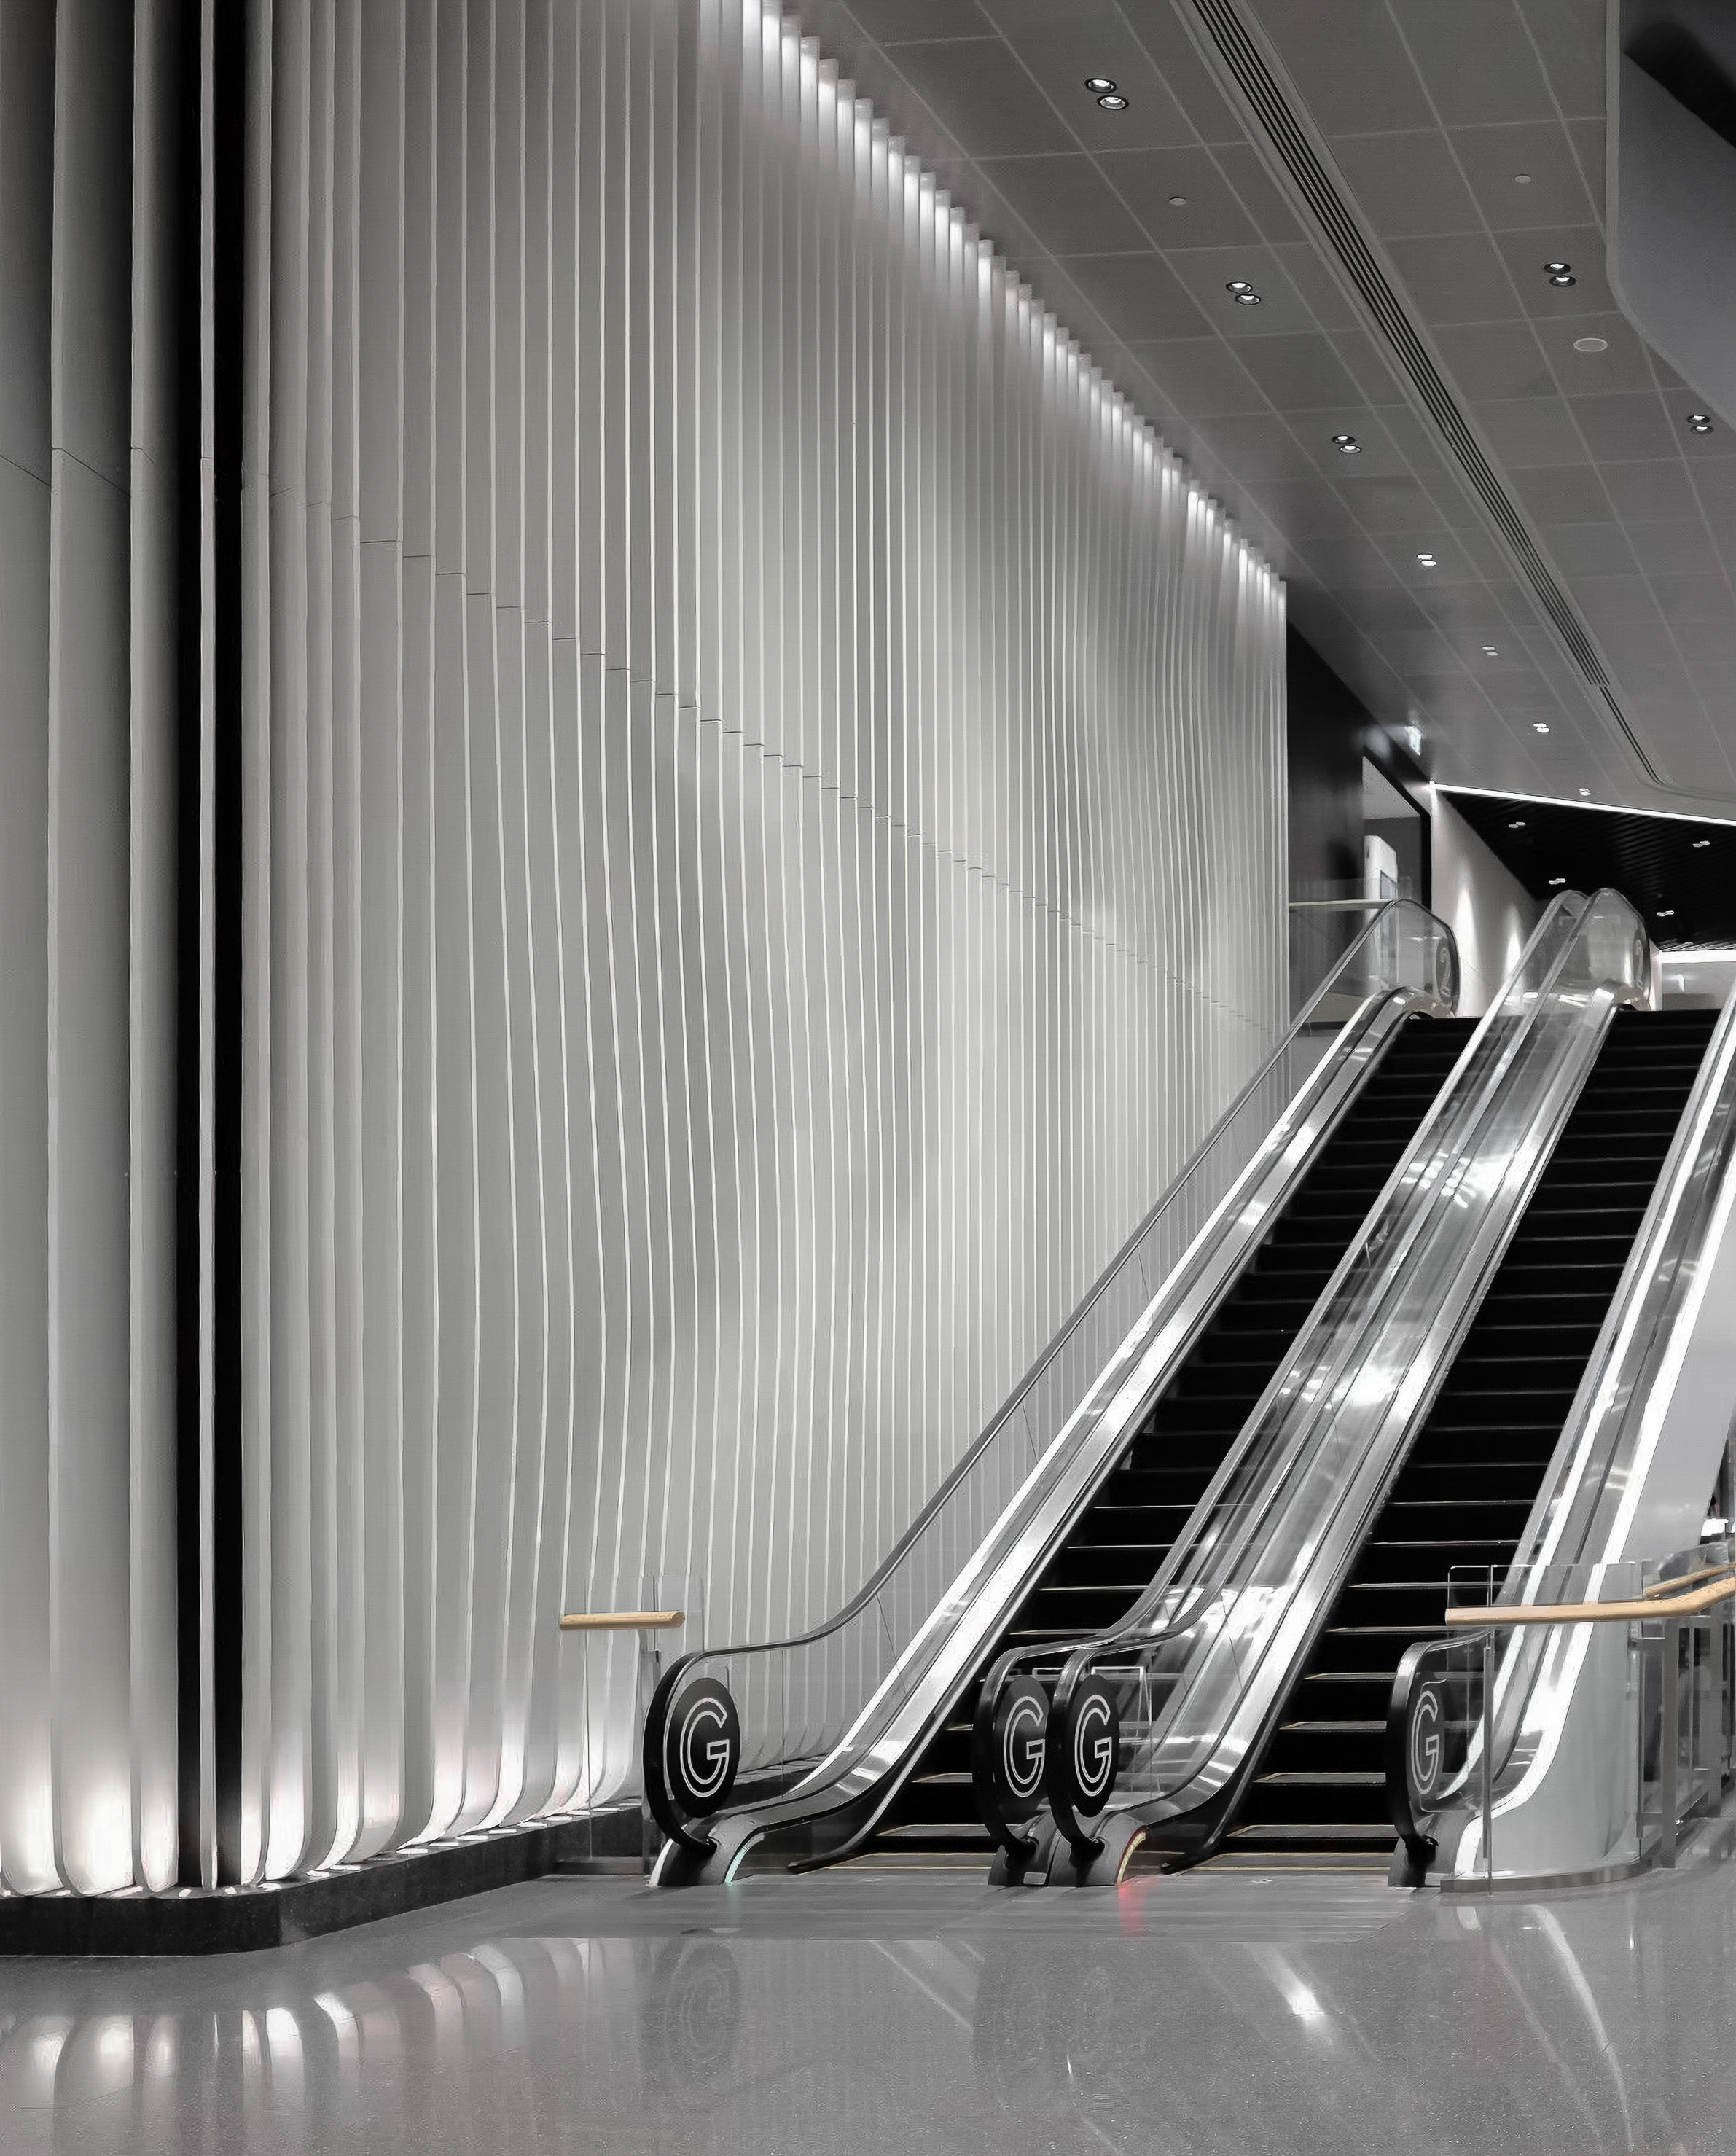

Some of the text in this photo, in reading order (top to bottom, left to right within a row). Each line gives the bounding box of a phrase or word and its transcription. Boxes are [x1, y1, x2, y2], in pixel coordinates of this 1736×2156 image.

[679, 1697, 730, 1798] G
[1004, 1696, 1046, 1797] G
[1075, 1695, 1112, 1797] G
[1411, 1690, 1439, 1794] G
